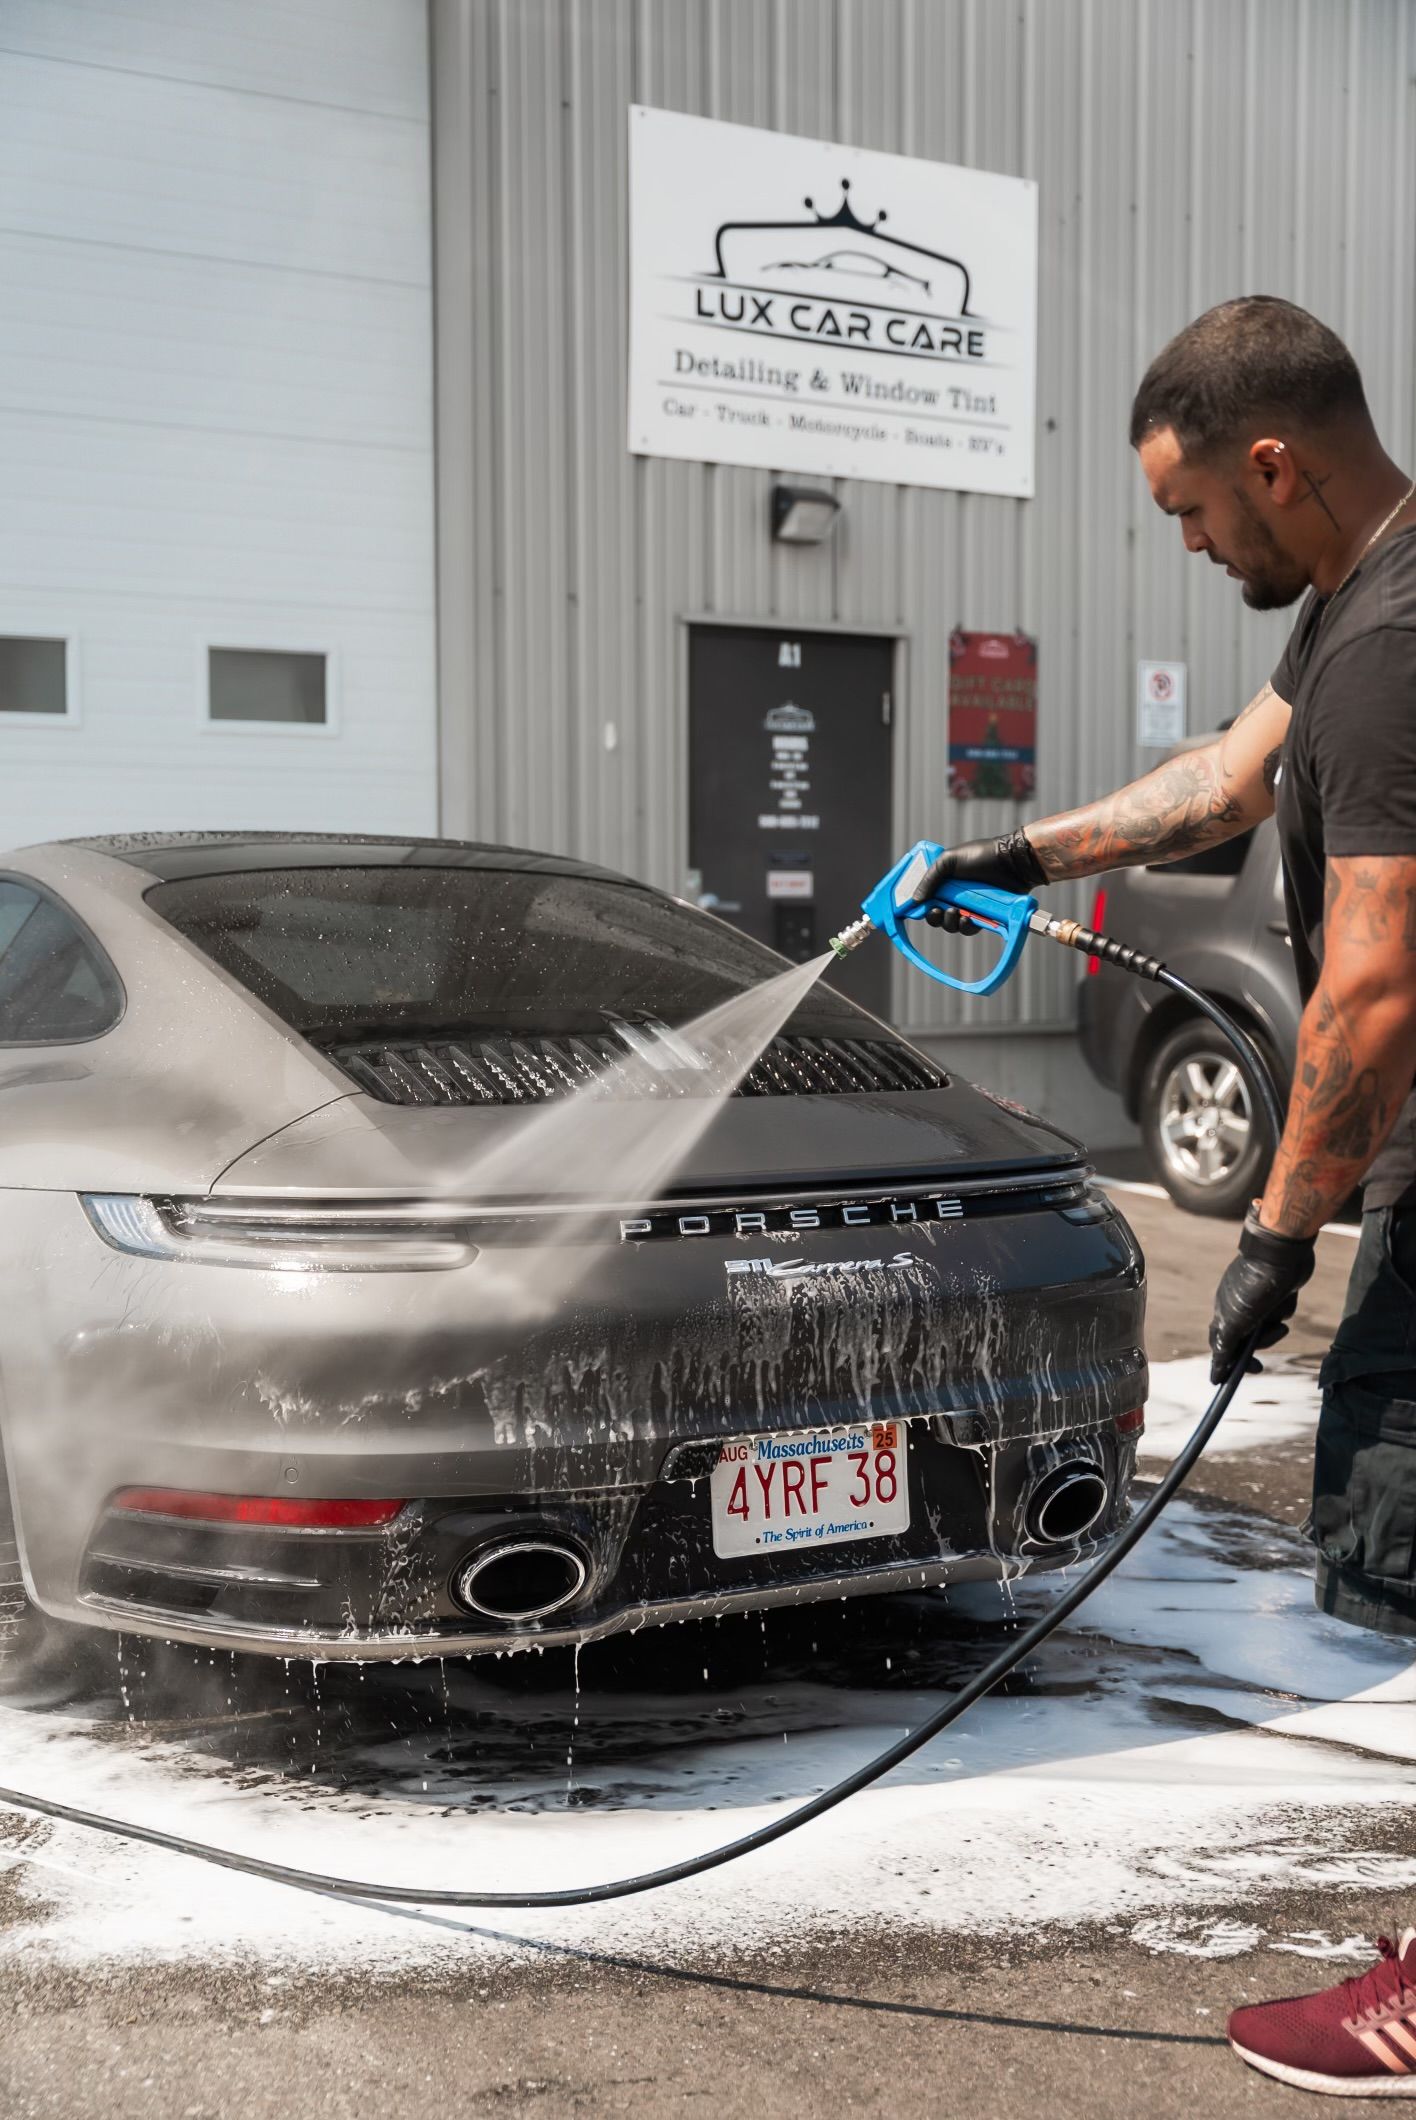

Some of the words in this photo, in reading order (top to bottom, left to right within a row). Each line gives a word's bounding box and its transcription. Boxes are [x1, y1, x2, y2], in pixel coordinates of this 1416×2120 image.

[696, 288, 773, 327] LUX
[790, 304, 871, 342] CAR
[886, 319, 985, 358] CARE
[674, 349, 801, 392] Detailing
[810, 367, 829, 391] &
[841, 371, 939, 407] Window
[948, 386, 997, 414] Tint
[662, 397, 695, 418] Car
[717, 404, 770, 426] Truck
[789, 413, 887, 442] Motorcycle
[619, 1198, 964, 1240] PORSCHE
[724, 1257, 776, 1275] 911
[766, 1257, 886, 1280] Carrera
[887, 1251, 914, 1269] S
[719, 1445, 748, 1464] AUG
[757, 1432, 865, 1461] Massachusetts
[875, 1431, 894, 1449] 25
[727, 1455, 832, 1522] 4YRF
[847, 1449, 897, 1508] 38
[763, 1530, 782, 1544] The
[785, 1525, 812, 1541] Spirit
[815, 1524, 824, 1539] of
[826, 1519, 868, 1535] America
